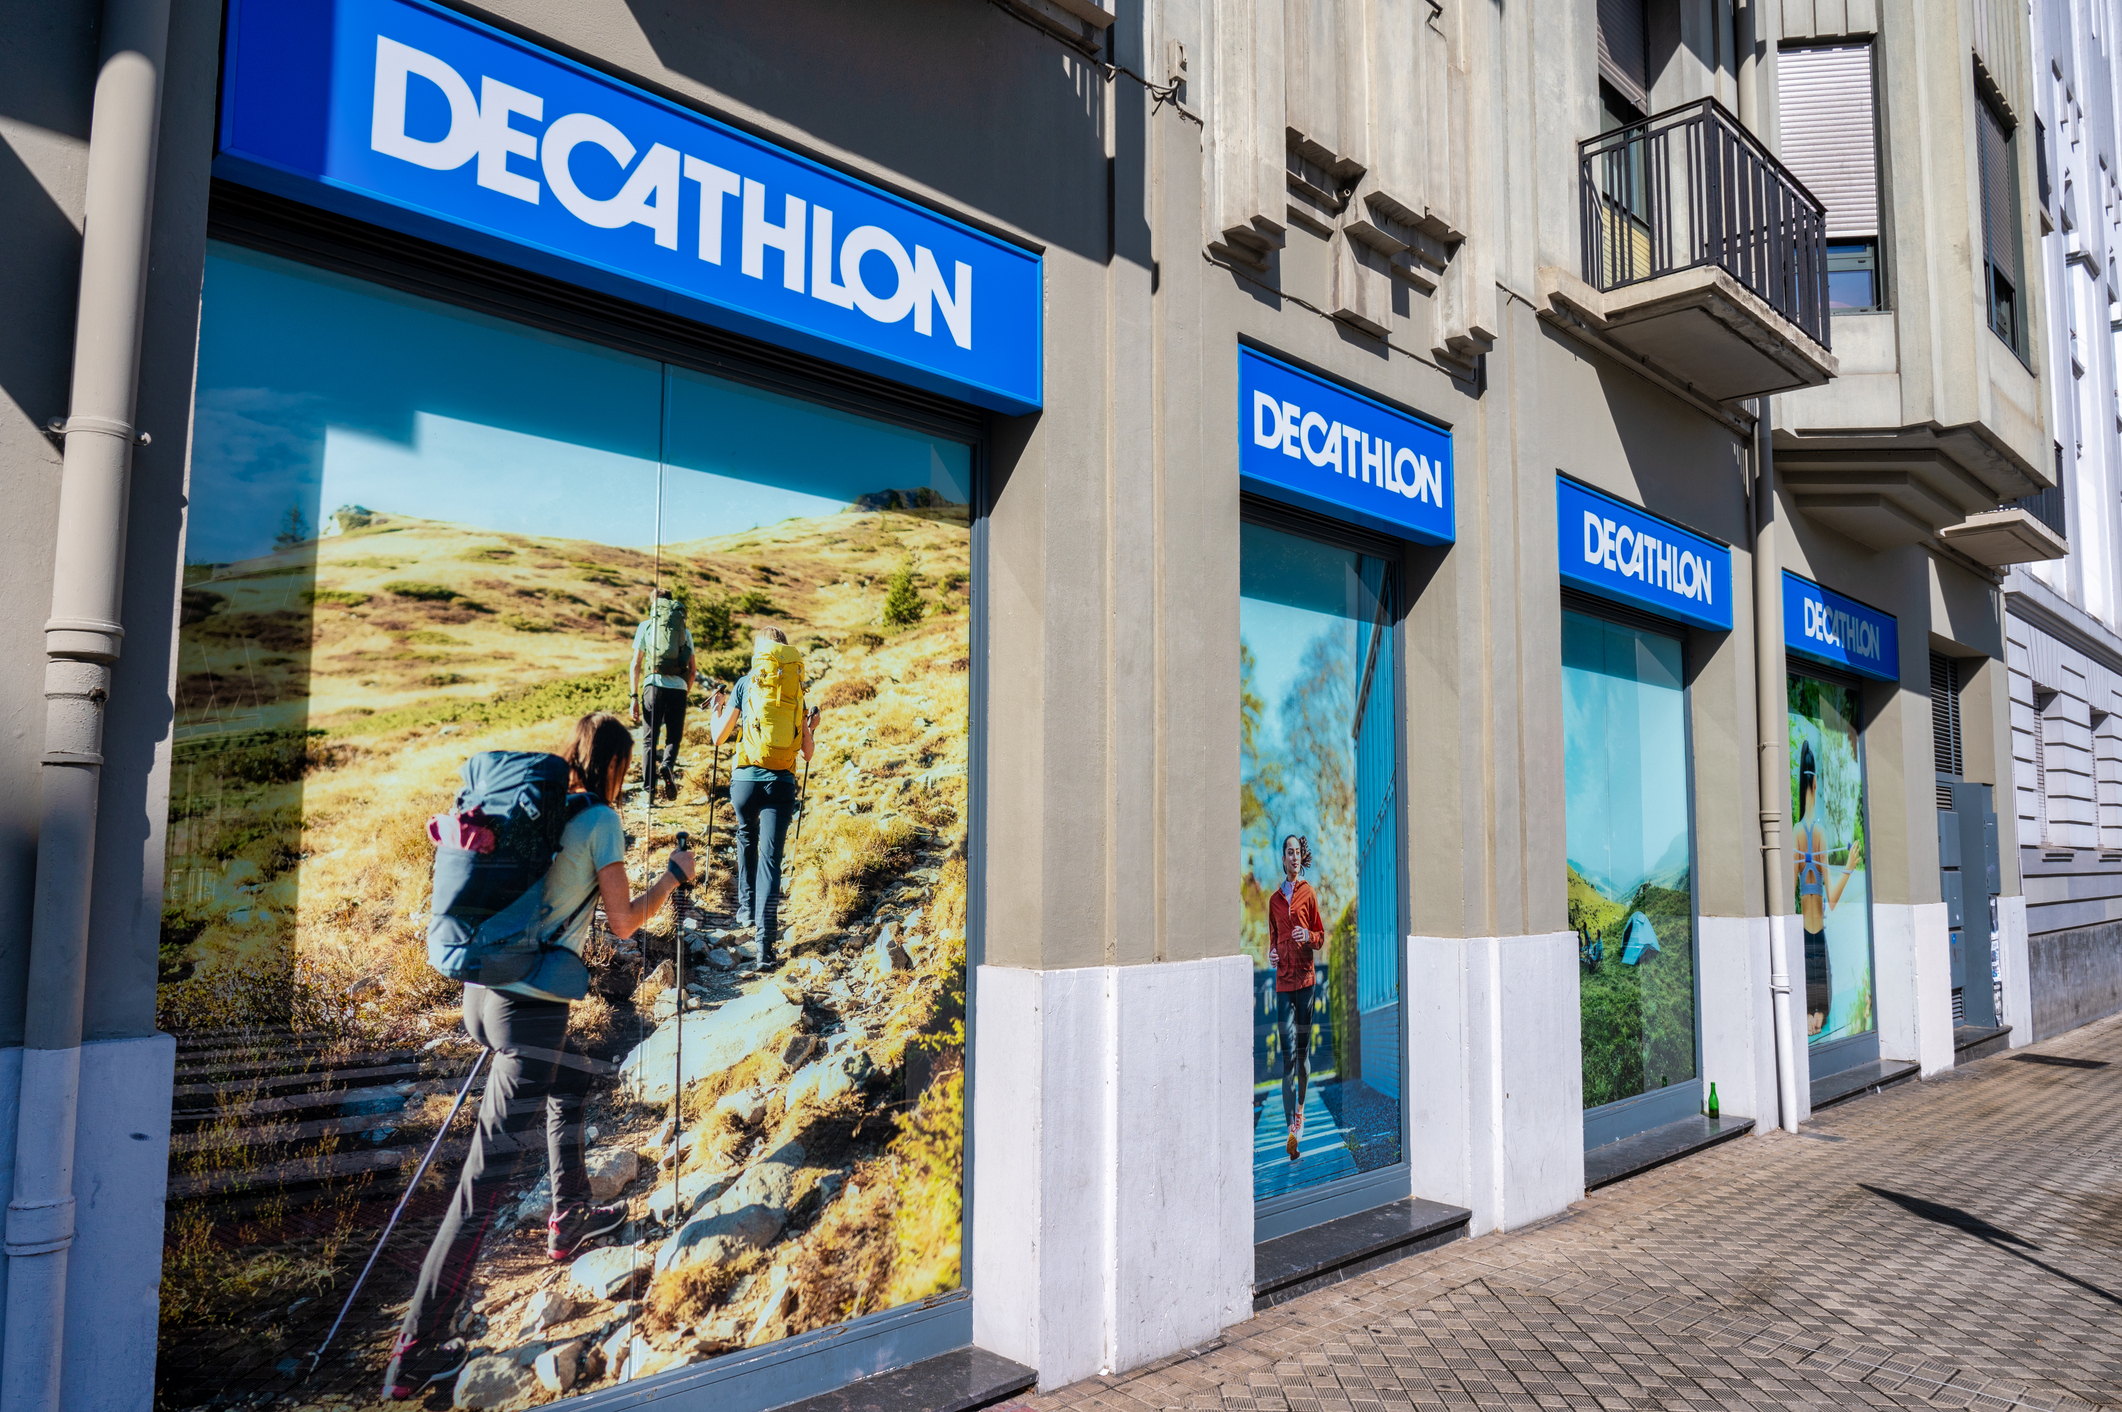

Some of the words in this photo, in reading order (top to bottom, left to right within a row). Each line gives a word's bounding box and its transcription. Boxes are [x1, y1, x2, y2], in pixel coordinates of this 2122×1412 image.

[371, 35, 973, 351] DECATHLON
[1253, 389, 1443, 509] DECATHLON
[1583, 510, 1712, 605] DECATHLON
[1804, 597, 1880, 661] DECATHLON
